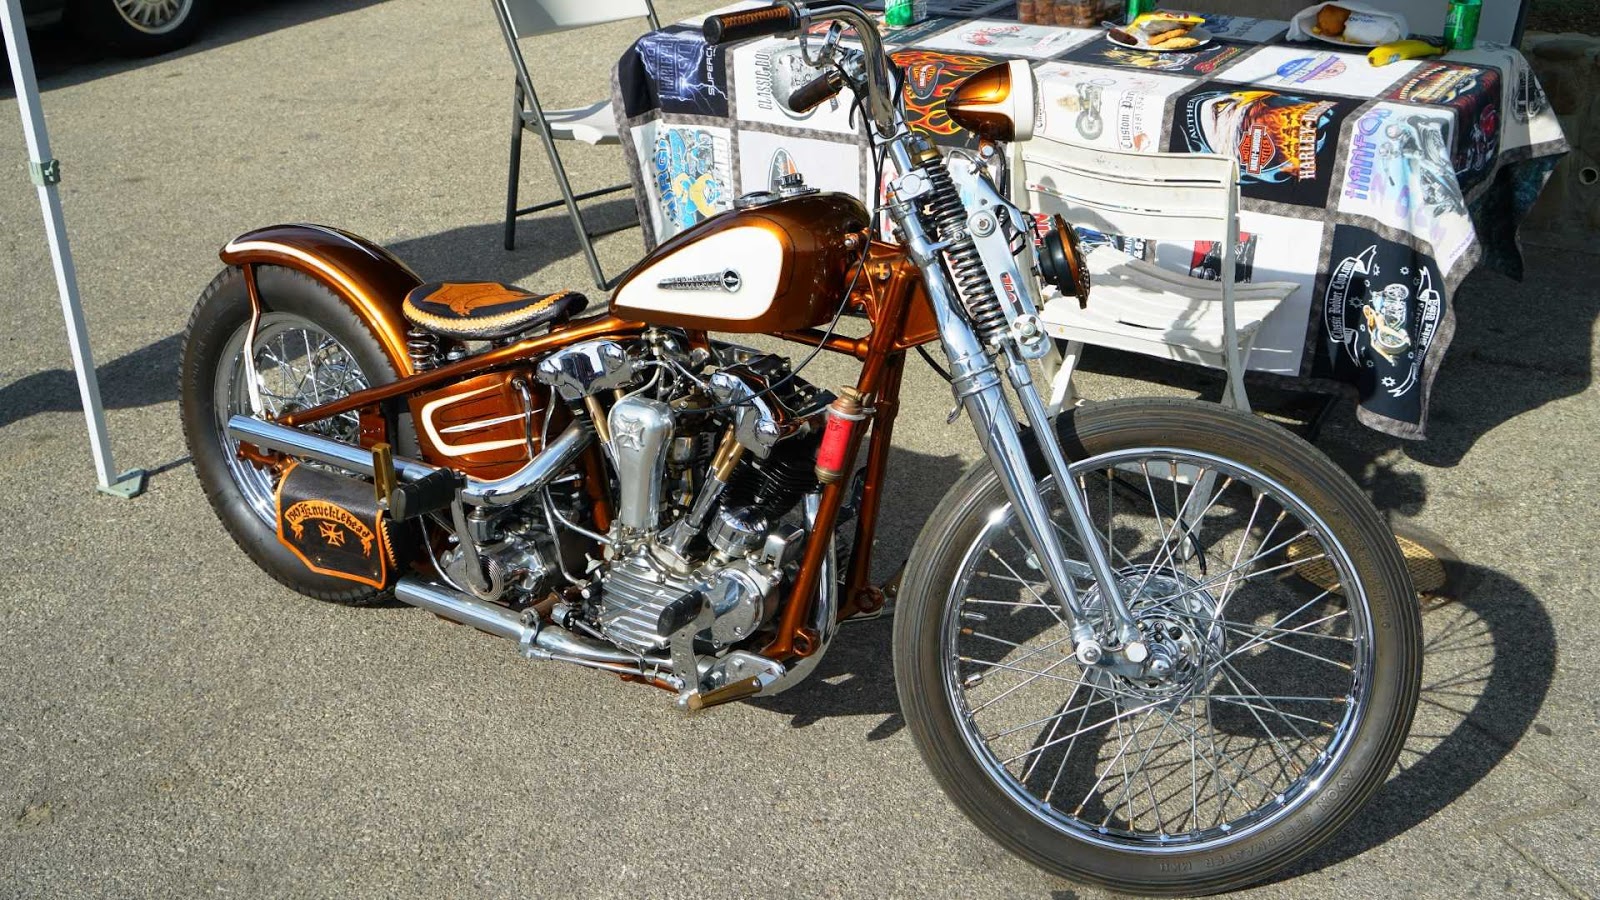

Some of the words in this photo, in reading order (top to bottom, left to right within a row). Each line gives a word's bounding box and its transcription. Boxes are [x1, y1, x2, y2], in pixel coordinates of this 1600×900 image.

[1120, 114, 1133, 149] Custom
[1186, 98, 1199, 139] AUTHEN
[299, 503, 370, 538] Knucklehead
[1318, 771, 1353, 813] AVON
[1204, 813, 1312, 868] SPEEDMASTER
